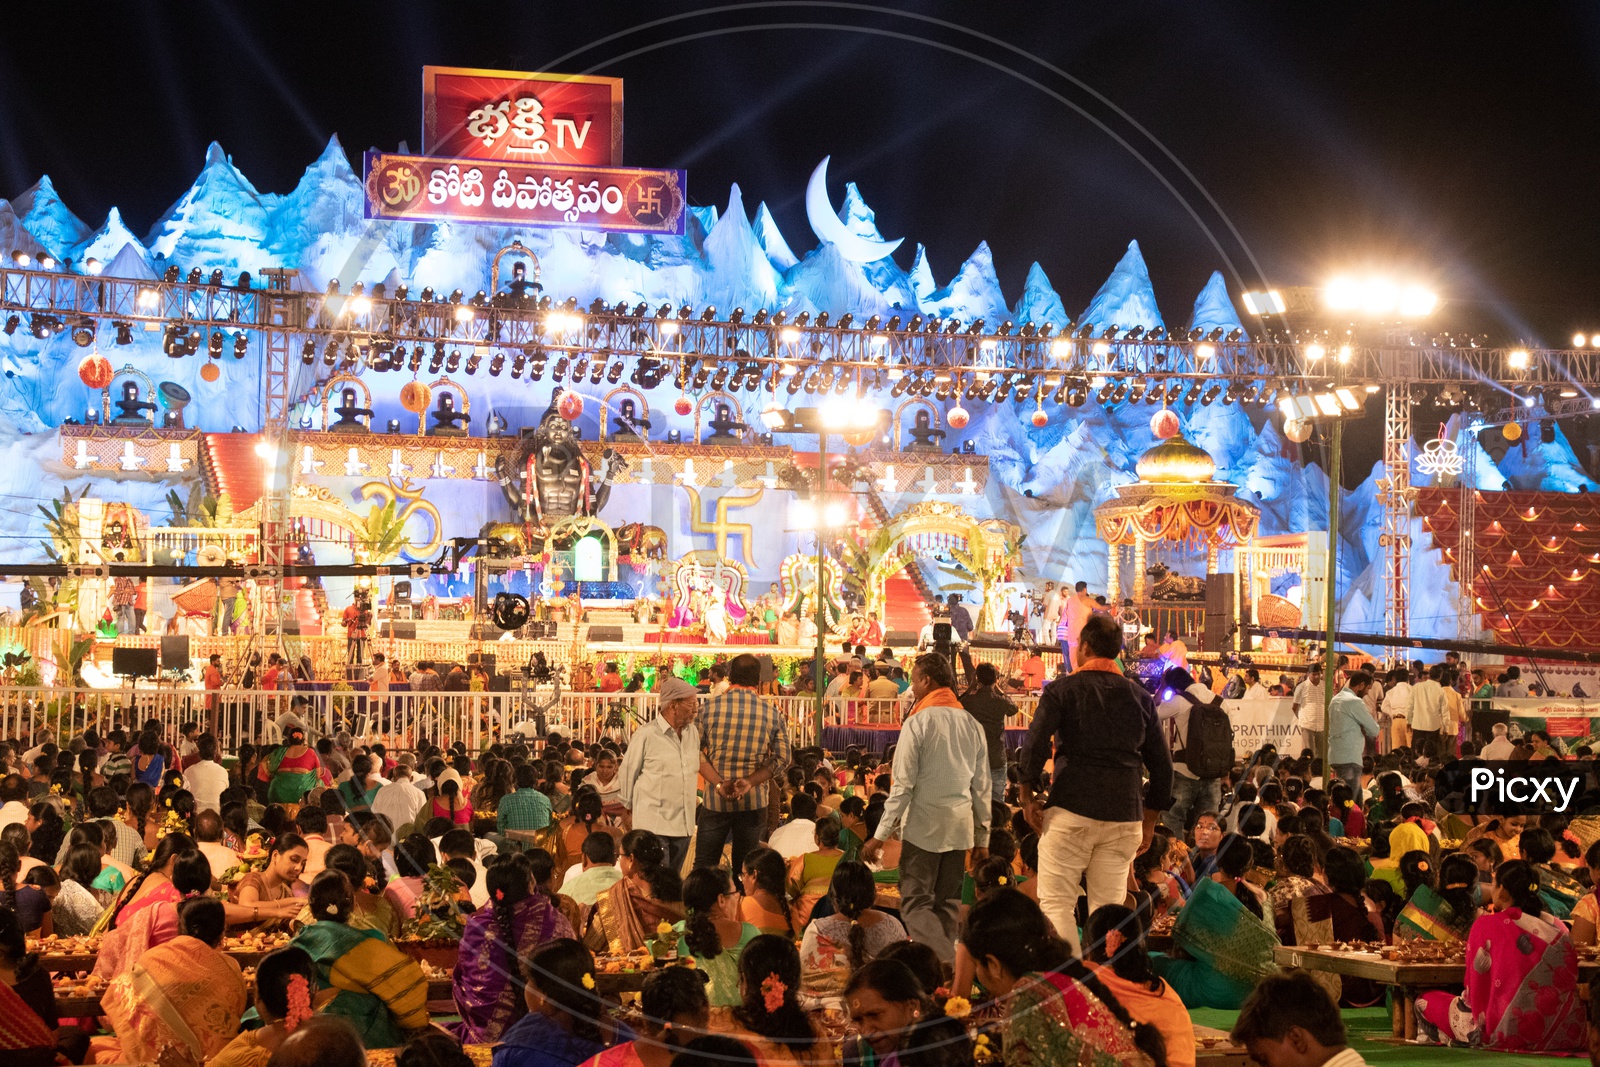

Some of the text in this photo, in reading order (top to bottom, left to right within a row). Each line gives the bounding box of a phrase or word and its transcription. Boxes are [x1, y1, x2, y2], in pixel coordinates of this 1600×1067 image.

[467, 97, 592, 154] భక్తి TV
[427, 164, 623, 222] కోటి దీపోత్సవం
[1232, 724, 1302, 736] PRATHIMA
[1233, 739, 1292, 748] HOSPITALS
